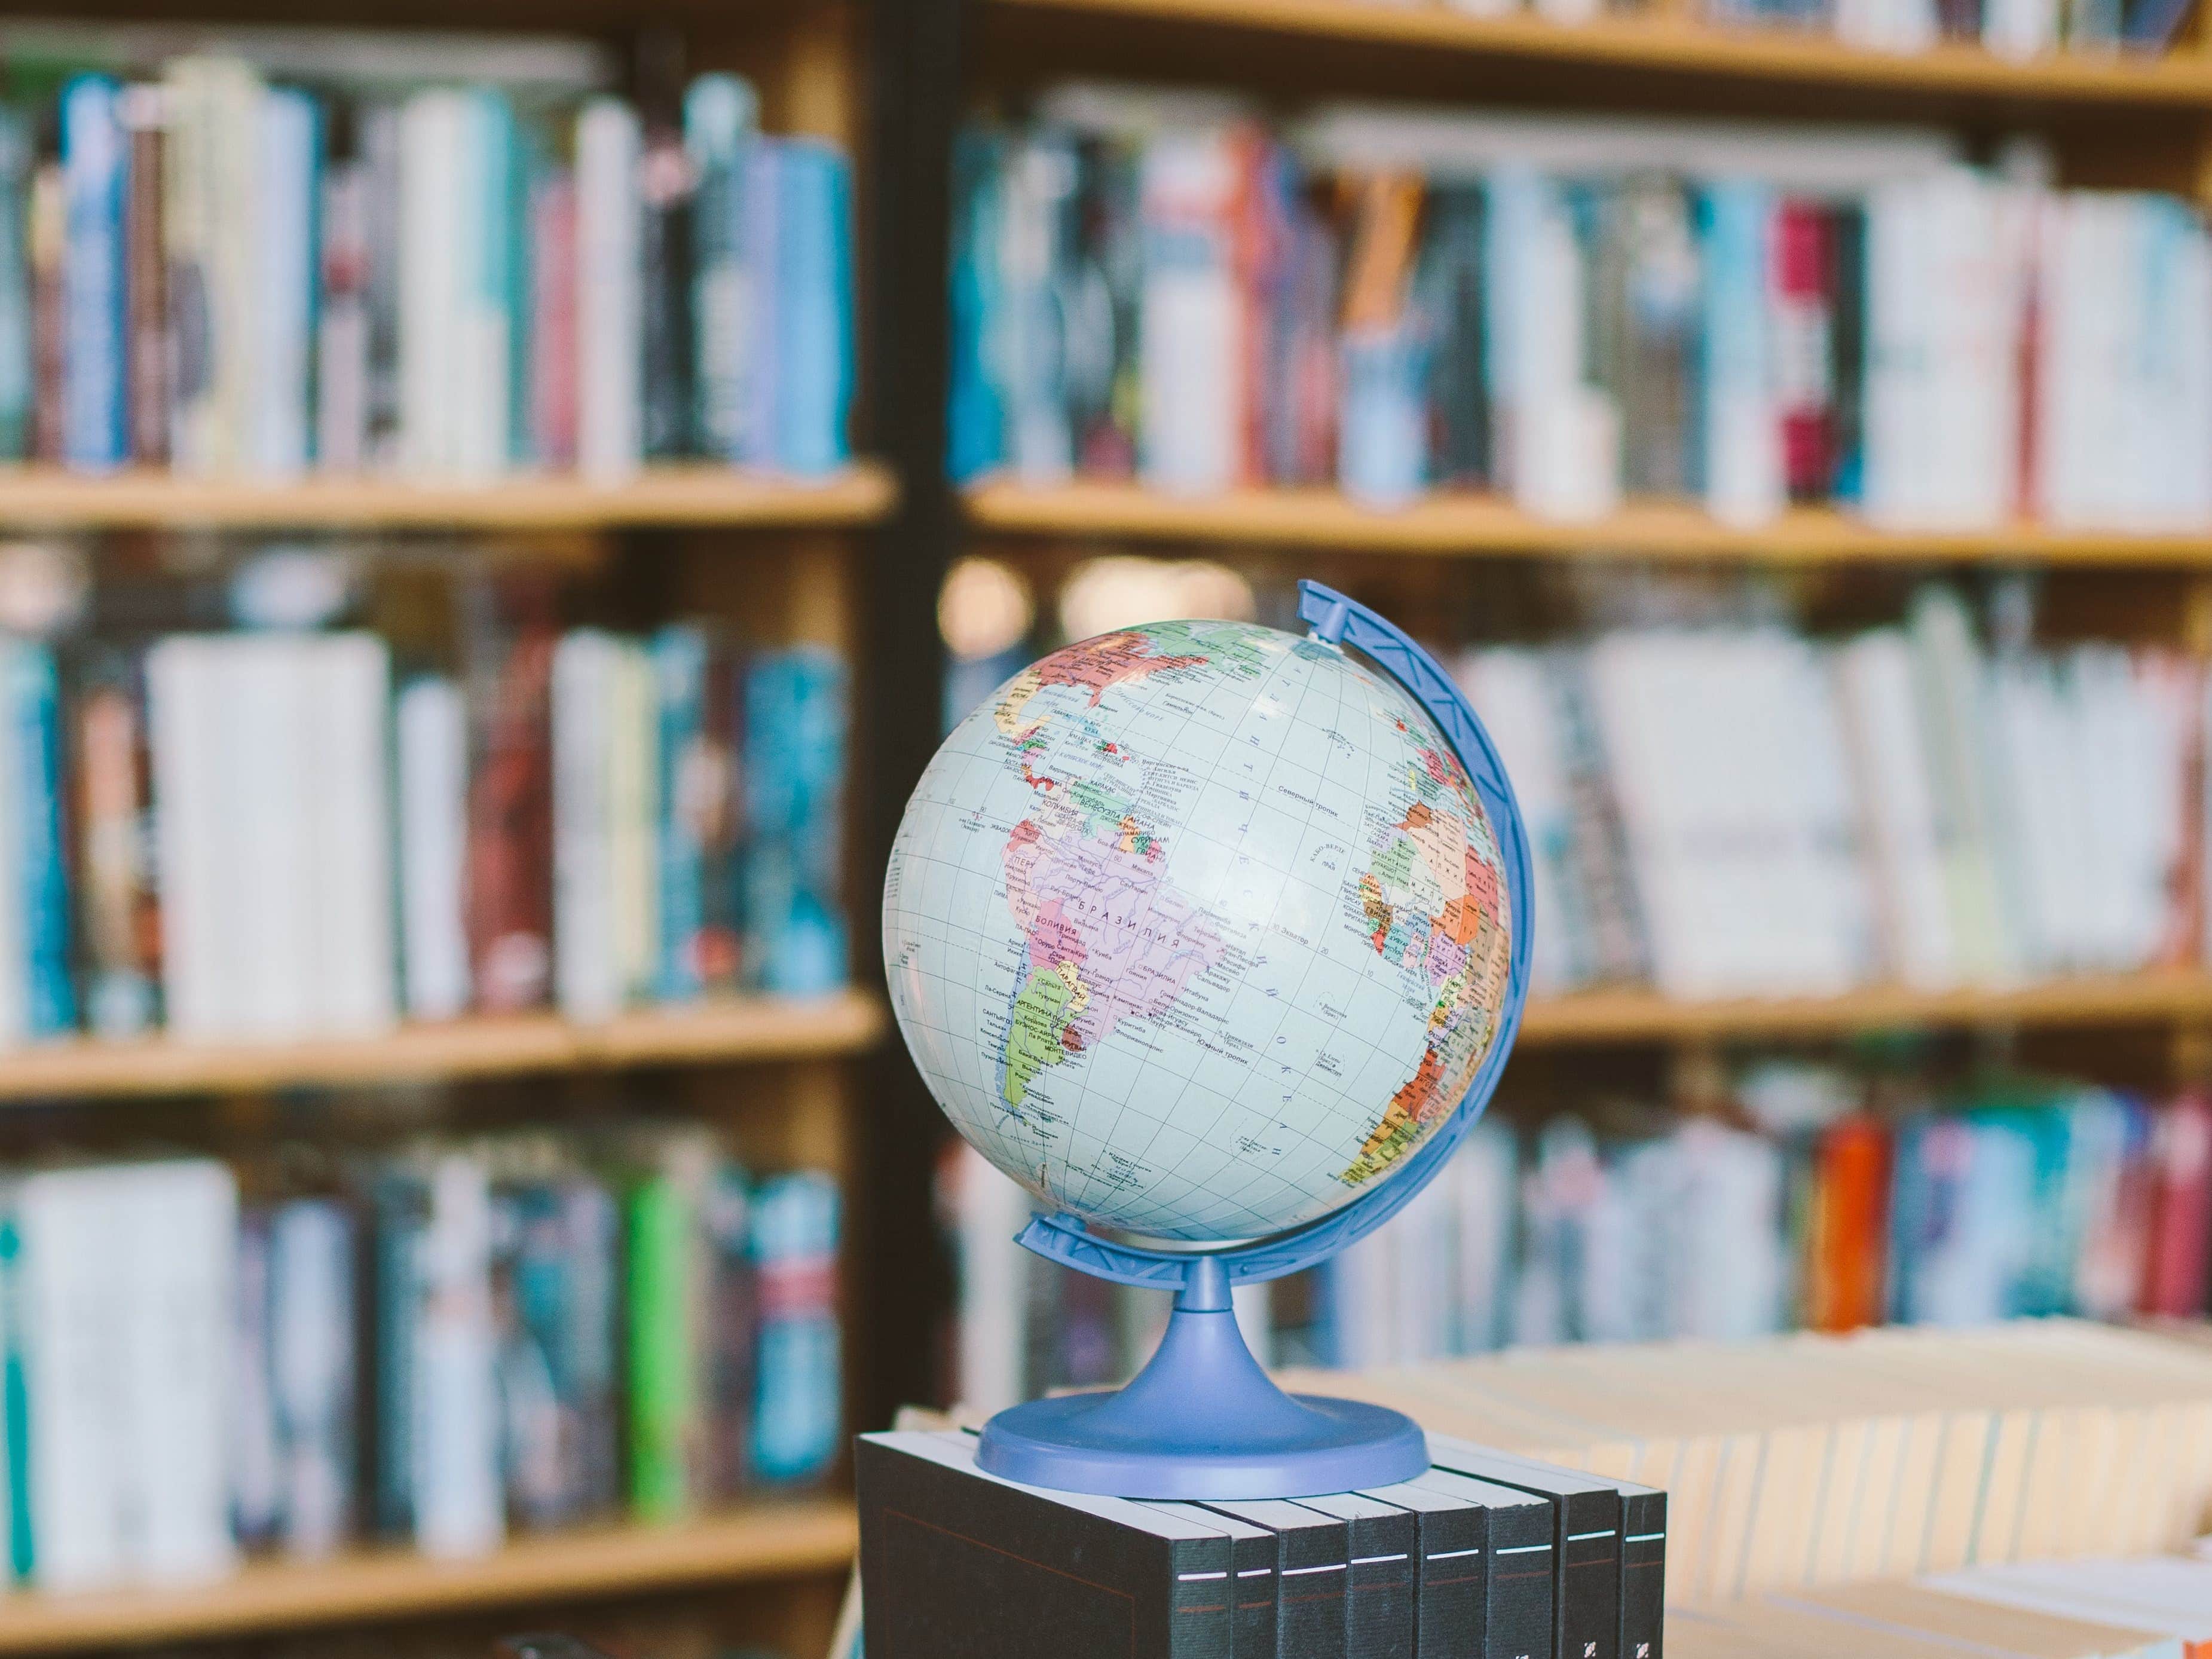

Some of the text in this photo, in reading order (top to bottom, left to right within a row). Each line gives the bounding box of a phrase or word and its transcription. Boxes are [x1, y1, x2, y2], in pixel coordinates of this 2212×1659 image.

[1090, 780, 1116, 794] КАРАКАС
[1042, 798, 1079, 816] КОЛУМБИЯ
[1080, 799, 1121, 820] ВЕНЕСУЭЛА
[1278, 785, 1339, 818] Северный тропик
[1015, 856, 1036, 868] ПЕРУ
[1132, 864, 1154, 876] Макапа
[1372, 850, 1411, 873] МАВРИТАНИЯ
[1374, 860, 1397, 874] НУАКШОТ
[994, 890, 1008, 900] ЛИМА
[1366, 907, 1391, 923] ГВИНЕЯ
[1035, 915, 1077, 936] БОЛИВИЯ
[1078, 901, 1180, 949] БРАЗИЛИЯ
[1038, 935, 1055, 949] Оруро
[1176, 929, 1206, 949] Флориану
[1281, 927, 1309, 945] Экватор
[1057, 942, 1089, 960] Санта-Крус
[1320, 947, 1329, 955] 20
[1041, 978, 1061, 990] Сальта
[1142, 965, 1176, 985] БРАЗИЛИА
[1197, 974, 1231, 993] Сальвадор
[1205, 968, 1231, 985] Аракажу
[1113, 993, 1143, 1011] Кампинас
[1184, 987, 1209, 1002] Итабуна
[1016, 999, 1053, 1018] АРГЕНТИНА
[1024, 1015, 1047, 1027] Кордова
[1069, 1012, 1096, 1026] Корумба
[1117, 1018, 1146, 1034] Куритиба
[1015, 1019, 1059, 1040] БУЭНОС-АЙРЕС
[1116, 1029, 1163, 1054] Флорианополис
[1044, 1045, 1087, 1060] МОНТЕВИДЕО
[1197, 1036, 1249, 1066] Южный тропик
